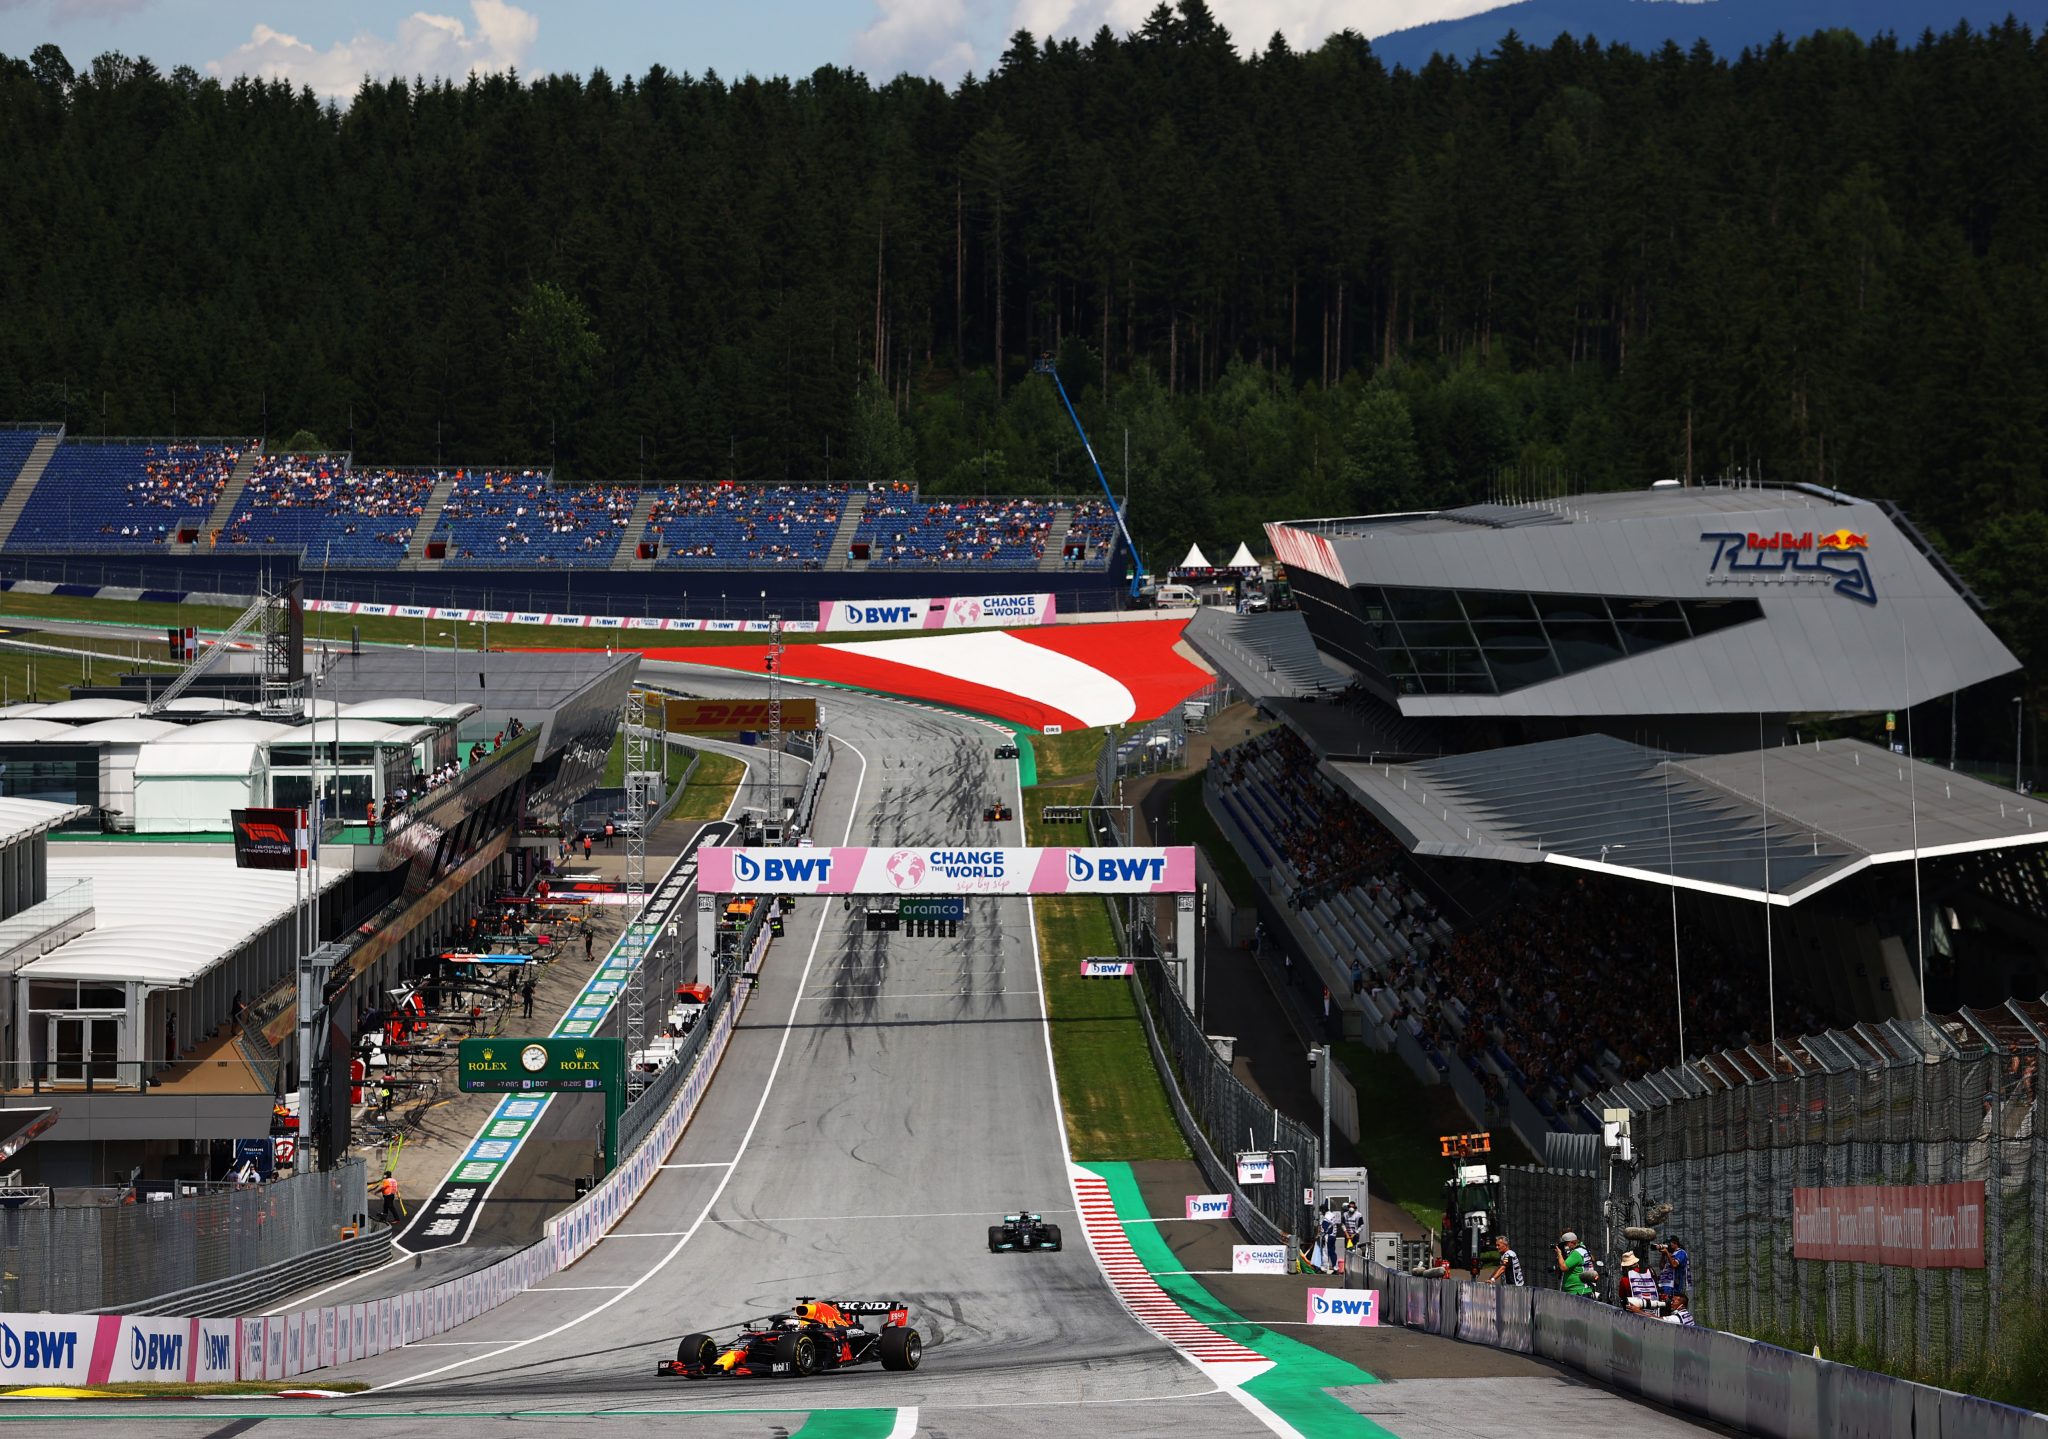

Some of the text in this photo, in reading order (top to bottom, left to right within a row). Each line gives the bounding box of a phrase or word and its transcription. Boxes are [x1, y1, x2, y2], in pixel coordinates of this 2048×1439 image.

[1747, 531, 1813, 550] Red Bull
[1701, 533, 1877, 607] Ring
[983, 597, 1035, 607] CHANGE
[865, 606, 911, 624] BWT
[994, 607, 1036, 616] WORLD
[930, 851, 1004, 864] CHANGE
[764, 859, 831, 881] BWT
[945, 866, 1005, 878] WORLD
[1099, 858, 1165, 881] BWT
[903, 905, 959, 914] aramco
[1101, 965, 1122, 973] BWT
[468, 1062, 507, 1071] ROLEX
[560, 1061, 600, 1070] ROLEX
[1249, 1162, 1270, 1170] BWT
[1202, 1202, 1228, 1212] BWT
[1332, 1300, 1372, 1315] BWT
[24, 1331, 77, 1368] BWT
[147, 1334, 182, 1370] BWT
[211, 1335, 230, 1369] BWT
[772, 1362, 785, 1372] Mobil
